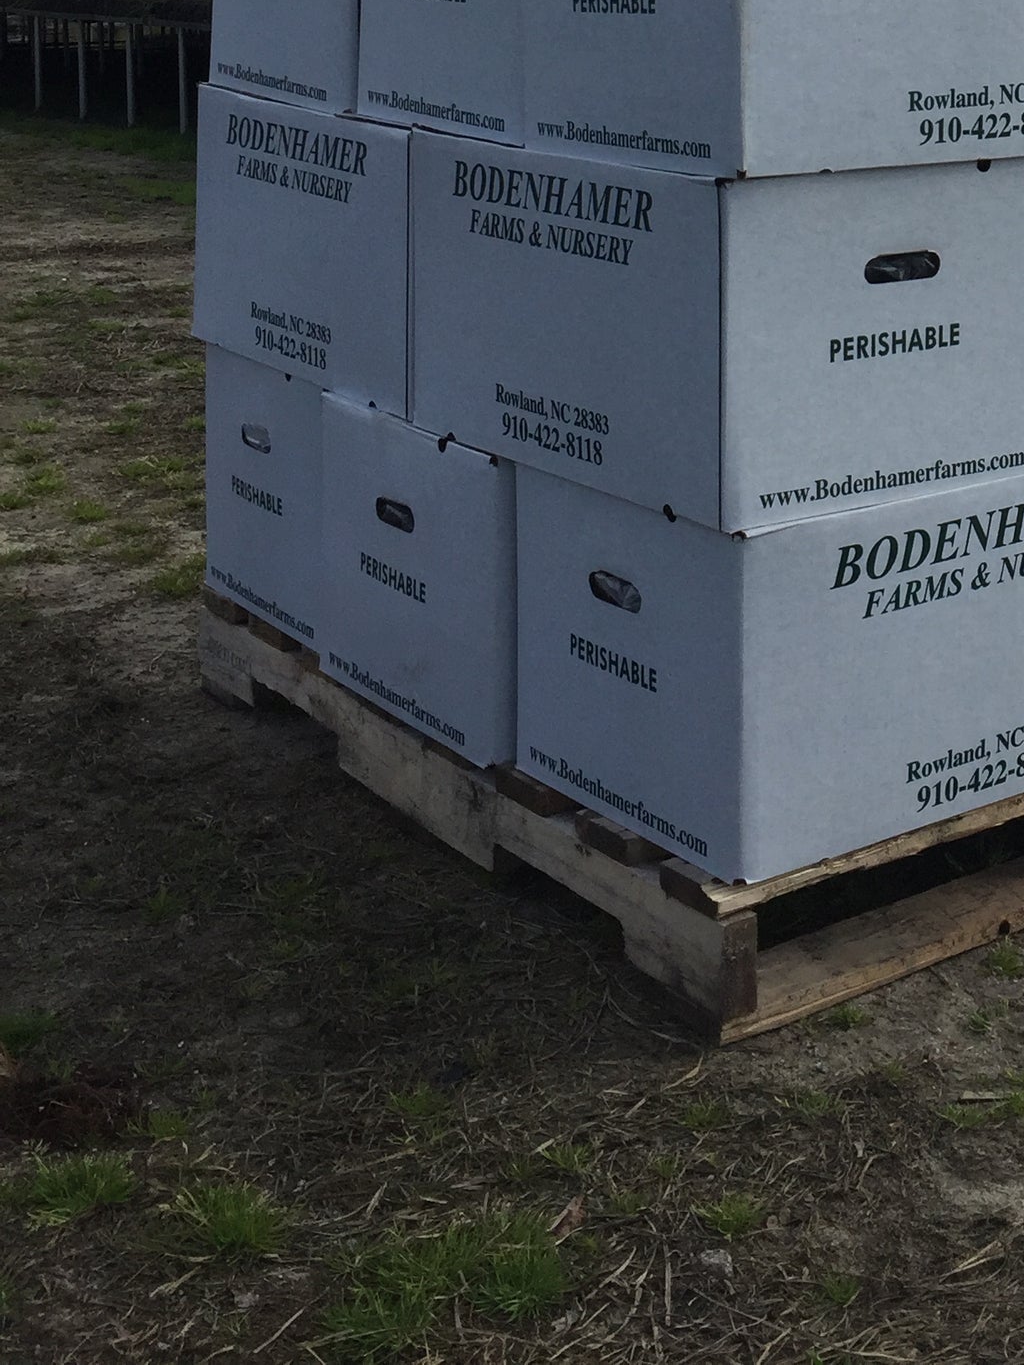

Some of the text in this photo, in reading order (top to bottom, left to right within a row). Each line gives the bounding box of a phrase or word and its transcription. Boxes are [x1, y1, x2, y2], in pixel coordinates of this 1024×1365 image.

[218, 63, 327, 101] www.Bodenhamerfarms.com
[907, 86, 994, 112] Rowland,
[368, 90, 505, 132] www.Bodenhamerfarms.com
[226, 114, 367, 176] BODENHAMER
[537, 121, 711, 159] www.Bodenhamerfarms.com
[236, 155, 352, 204] FARMS & NURSERY
[452, 160, 653, 232] BODENHAMER
[469, 209, 634, 266] FARMS & NURSERY
[255, 325, 326, 370] 910-422-8118
[289, 315, 304, 335] NC
[305, 320, 331, 345] 28383
[830, 323, 960, 363] PERISHABLE
[496, 383, 609, 435] Rowland, NC 28383
[502, 412, 602, 466] 910-422-8118
[232, 475, 283, 516] PERISHABLE
[759, 452, 1024, 509] www.Bodenhamerfarms.com
[211, 566, 314, 639] www.Bodenhamerfarms.com
[361, 552, 426, 604] PERISHABLE
[862, 567, 964, 619] FARMS
[971, 562, 991, 590] &
[570, 633, 657, 693] PERISHABLE
[329, 651, 465, 746] www.Bodenhamerfarms.com
[906, 738, 991, 784] Rowland,
[530, 746, 707, 857] www.Bodenhamerfarms.com
